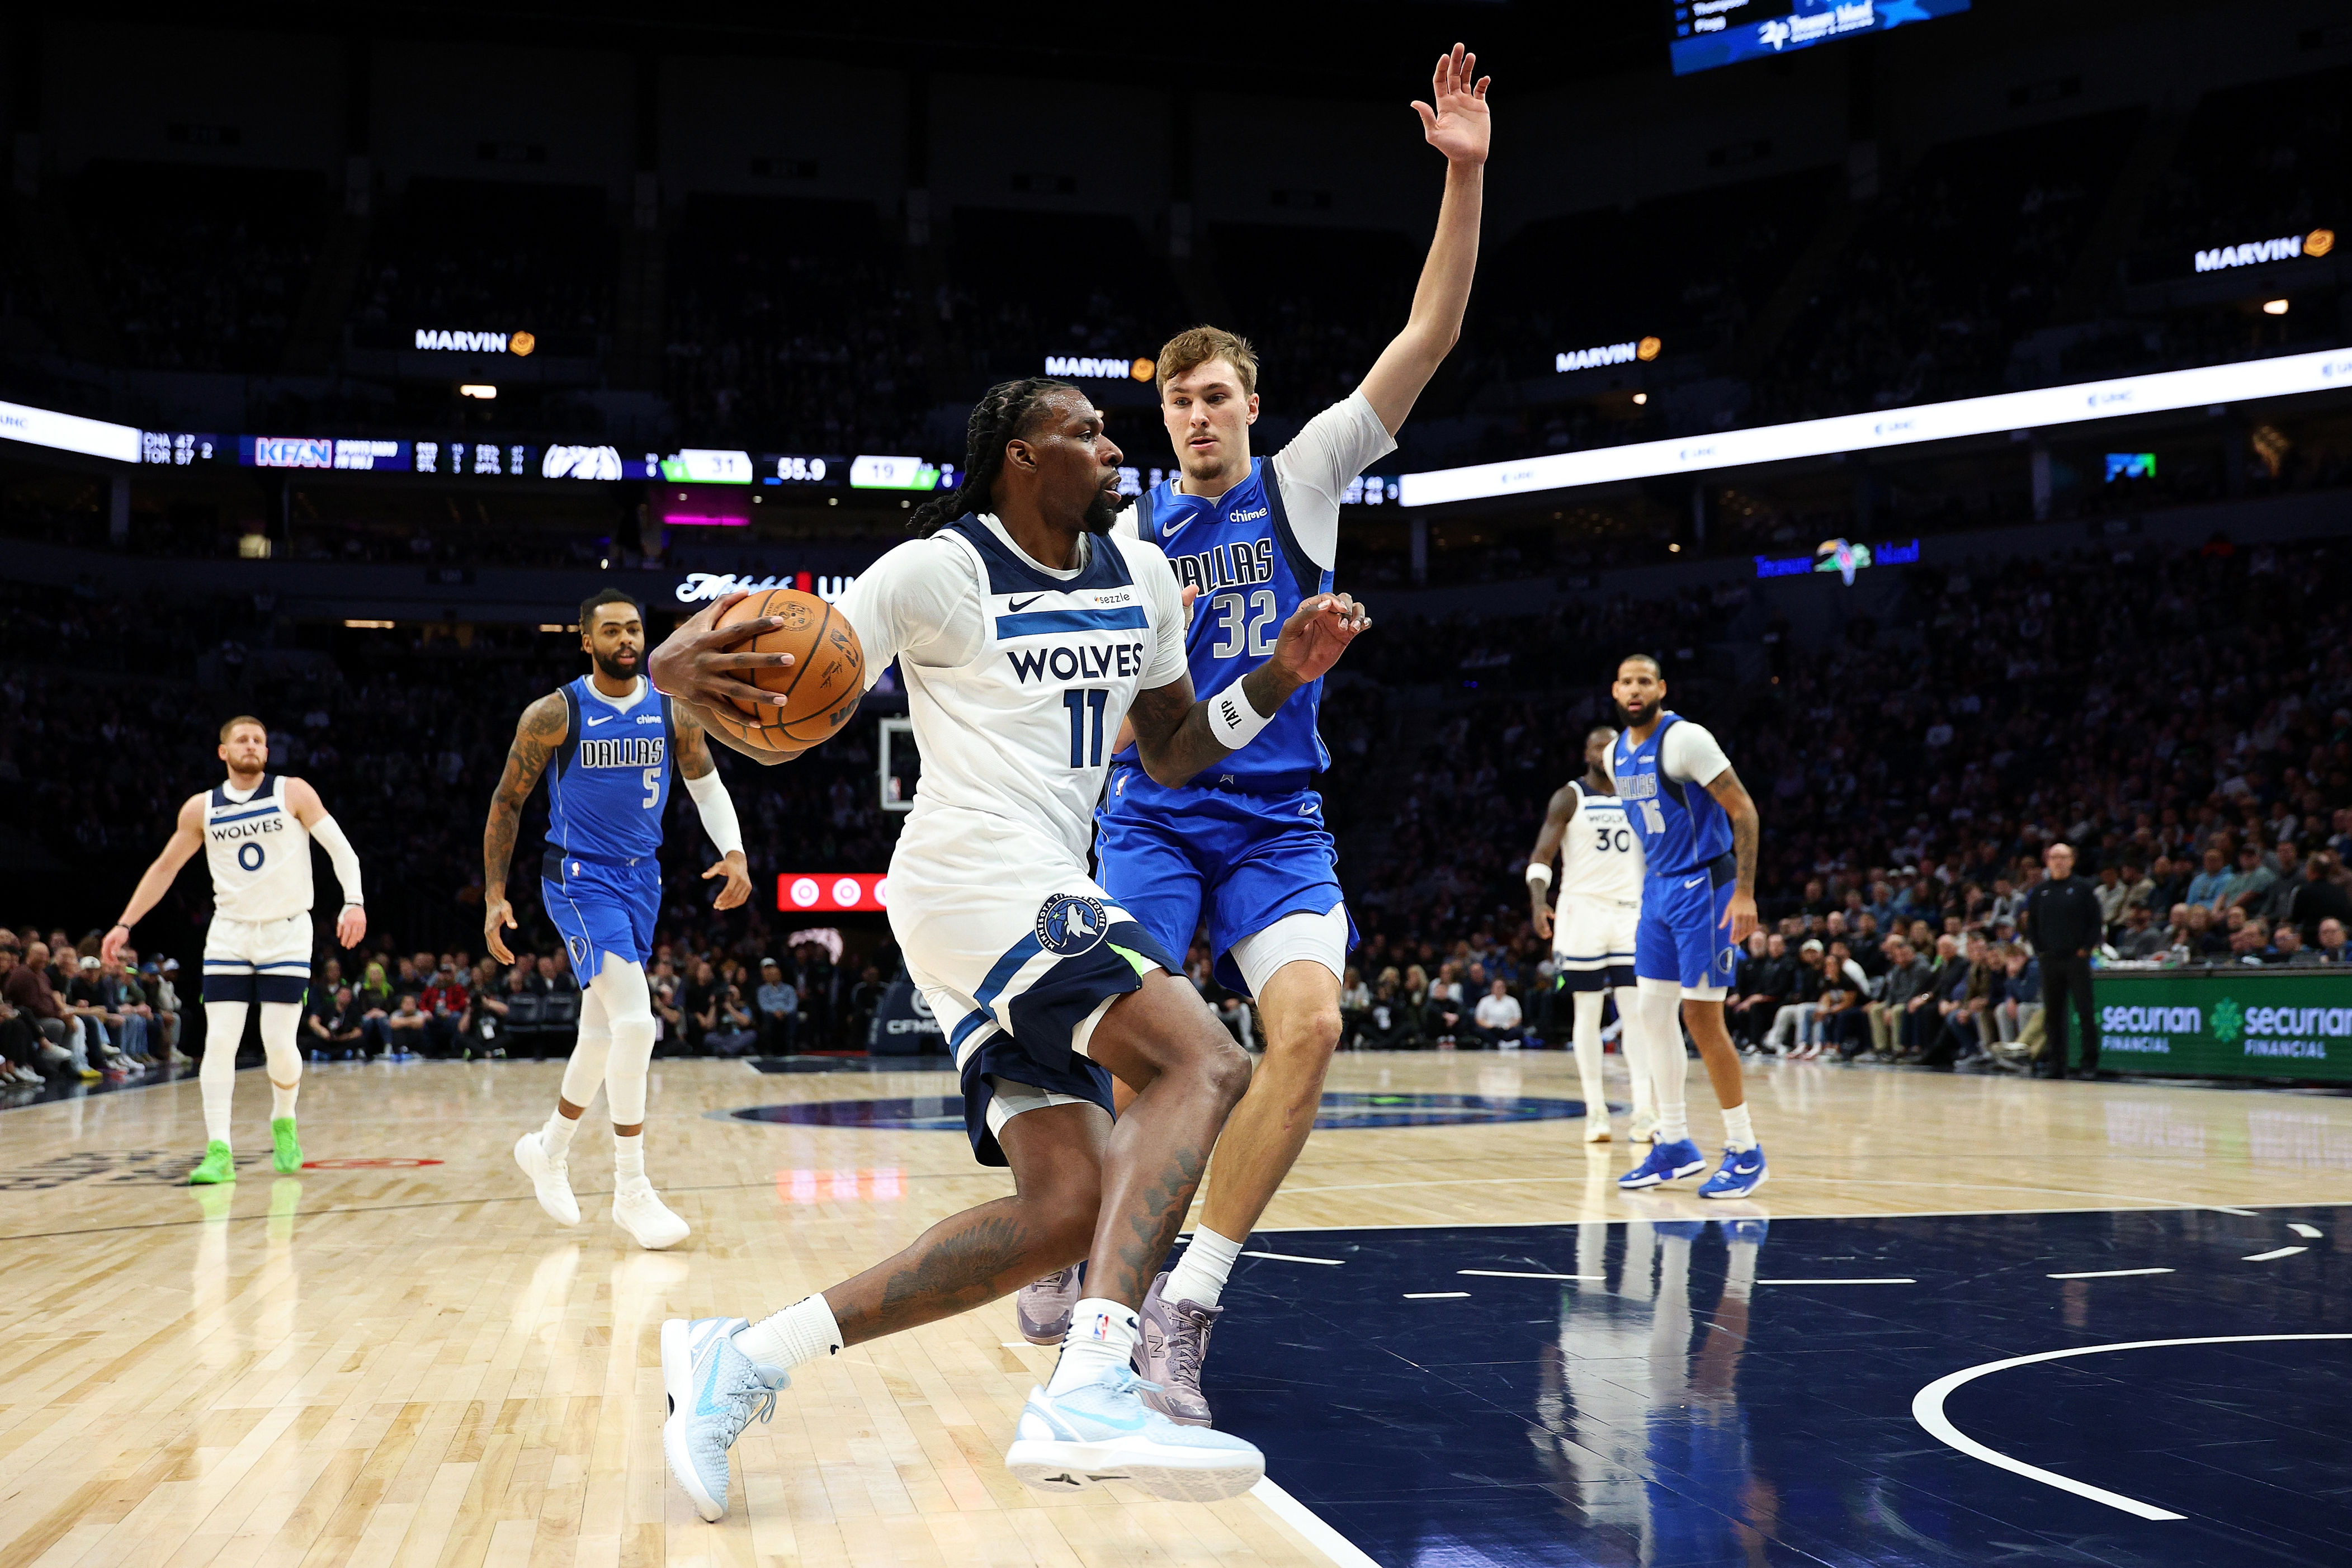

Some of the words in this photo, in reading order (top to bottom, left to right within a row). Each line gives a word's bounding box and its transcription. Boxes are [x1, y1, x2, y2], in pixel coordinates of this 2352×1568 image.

[2195, 235, 2301, 272] MARVIN
[415, 329, 507, 353] MARVIN
[1045, 356, 1129, 379] MARVIN
[1556, 342, 1636, 372] MARVIN
[143, 447, 171, 464] TOR
[200, 442, 213, 459] 2
[255, 437, 332, 468] KFAN
[712, 457, 733, 473] 31
[873, 464, 894, 479] 19
[1230, 507, 1268, 522] chime
[1168, 537, 1273, 598] ALLAS
[1099, 592, 1131, 604] sezzle
[1212, 589, 1278, 659] 32
[1007, 643, 1144, 685] WOLVES
[636, 714, 663, 725] chime
[1063, 688, 1109, 769] 11
[1221, 700, 1243, 730] TAYP
[580, 736, 665, 769] DALLAS
[643, 767, 662, 810] 5
[212, 818, 284, 842] WOLVES
[1637, 799, 1666, 834] 16
[1597, 828, 1630, 852] 30
[238, 841, 266, 871] 0
[1037, 901, 1055, 950] MINNESOTA
[1053, 893, 1106, 927] TIRWOLVES
[2101, 1005, 2202, 1034] securian
[2101, 1035, 2170, 1054] FINANCIAL
[2244, 1038, 2327, 1059] FINANCIAL
